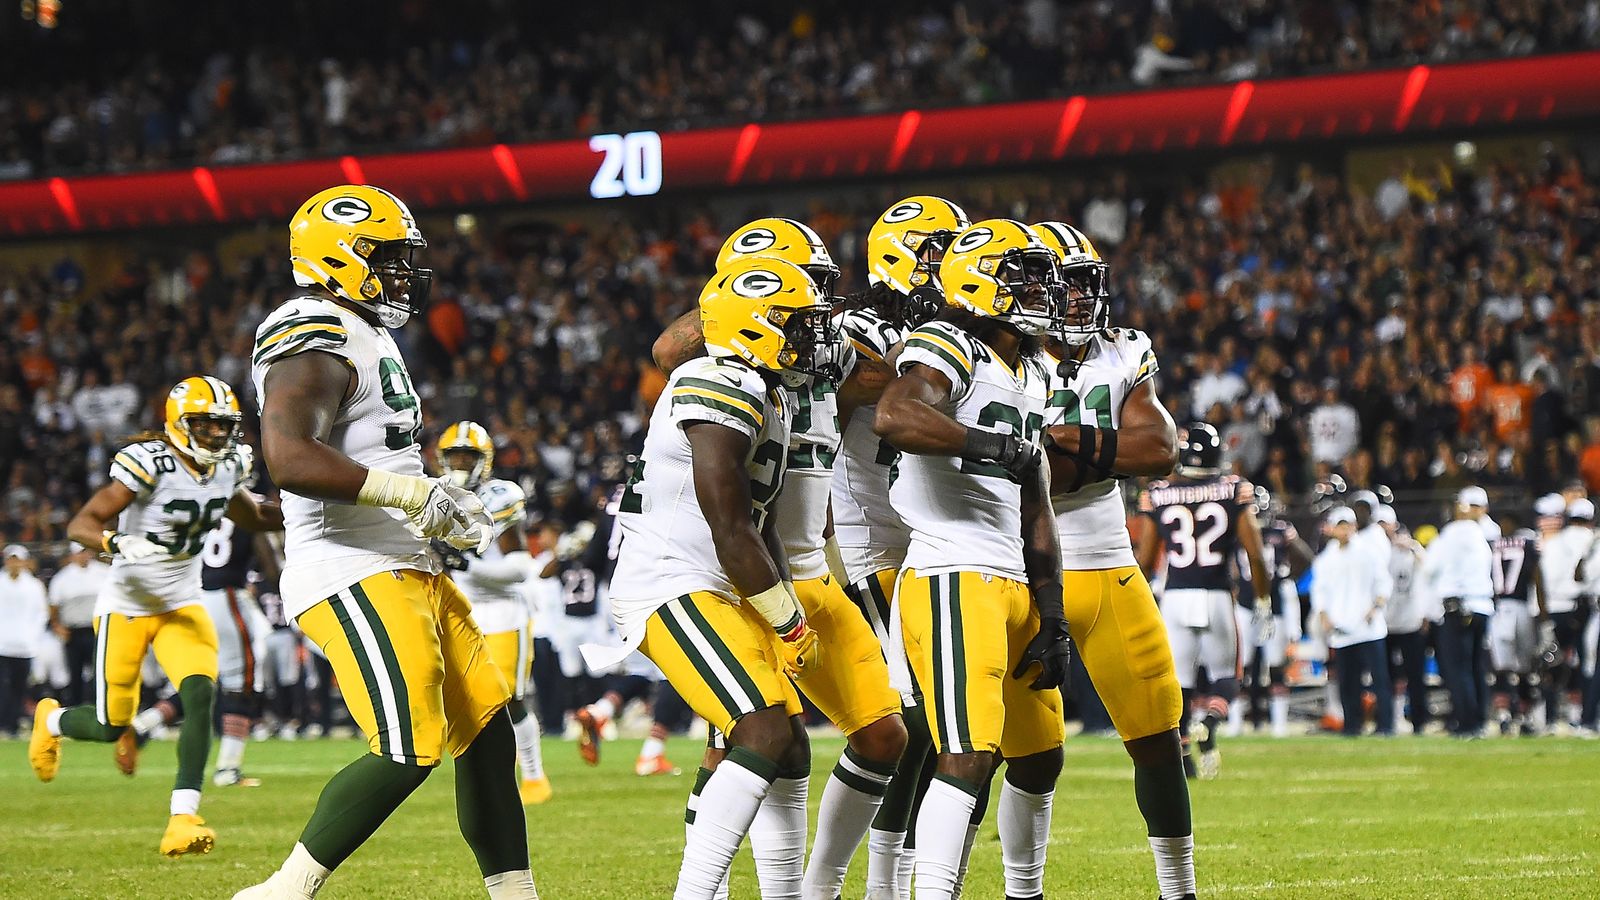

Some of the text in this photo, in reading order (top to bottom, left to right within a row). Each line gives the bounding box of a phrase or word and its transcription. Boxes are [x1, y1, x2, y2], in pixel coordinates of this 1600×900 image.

[589, 131, 662, 198] 20
[322, 196, 372, 224] G
[883, 202, 923, 223] G
[732, 228, 776, 254] G
[952, 227, 993, 254] G
[731, 270, 782, 299] G
[379, 357, 420, 450] 9
[1160, 502, 1229, 568] 32
[1493, 548, 1525, 595] 17
